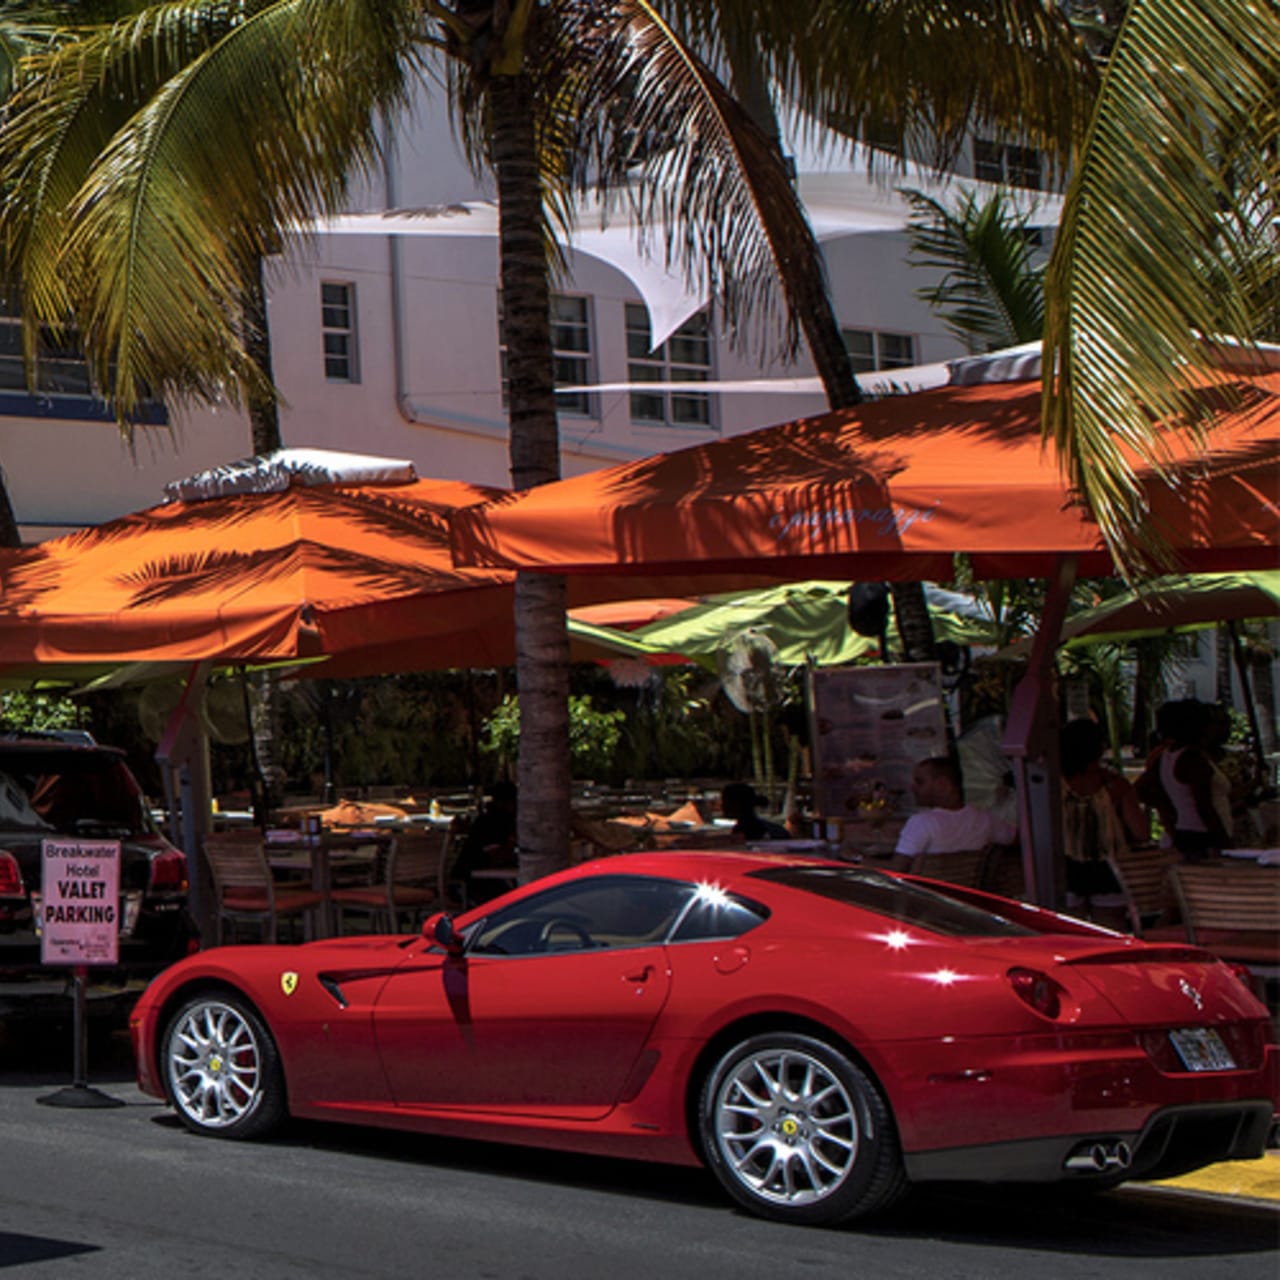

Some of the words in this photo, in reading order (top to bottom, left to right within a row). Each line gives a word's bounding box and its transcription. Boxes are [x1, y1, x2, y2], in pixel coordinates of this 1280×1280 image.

[45, 844, 117, 859] Breakwater
[66, 864, 100, 877] Hotel
[58, 880, 107, 899] VALET
[45, 905, 115, 924] PARKING
